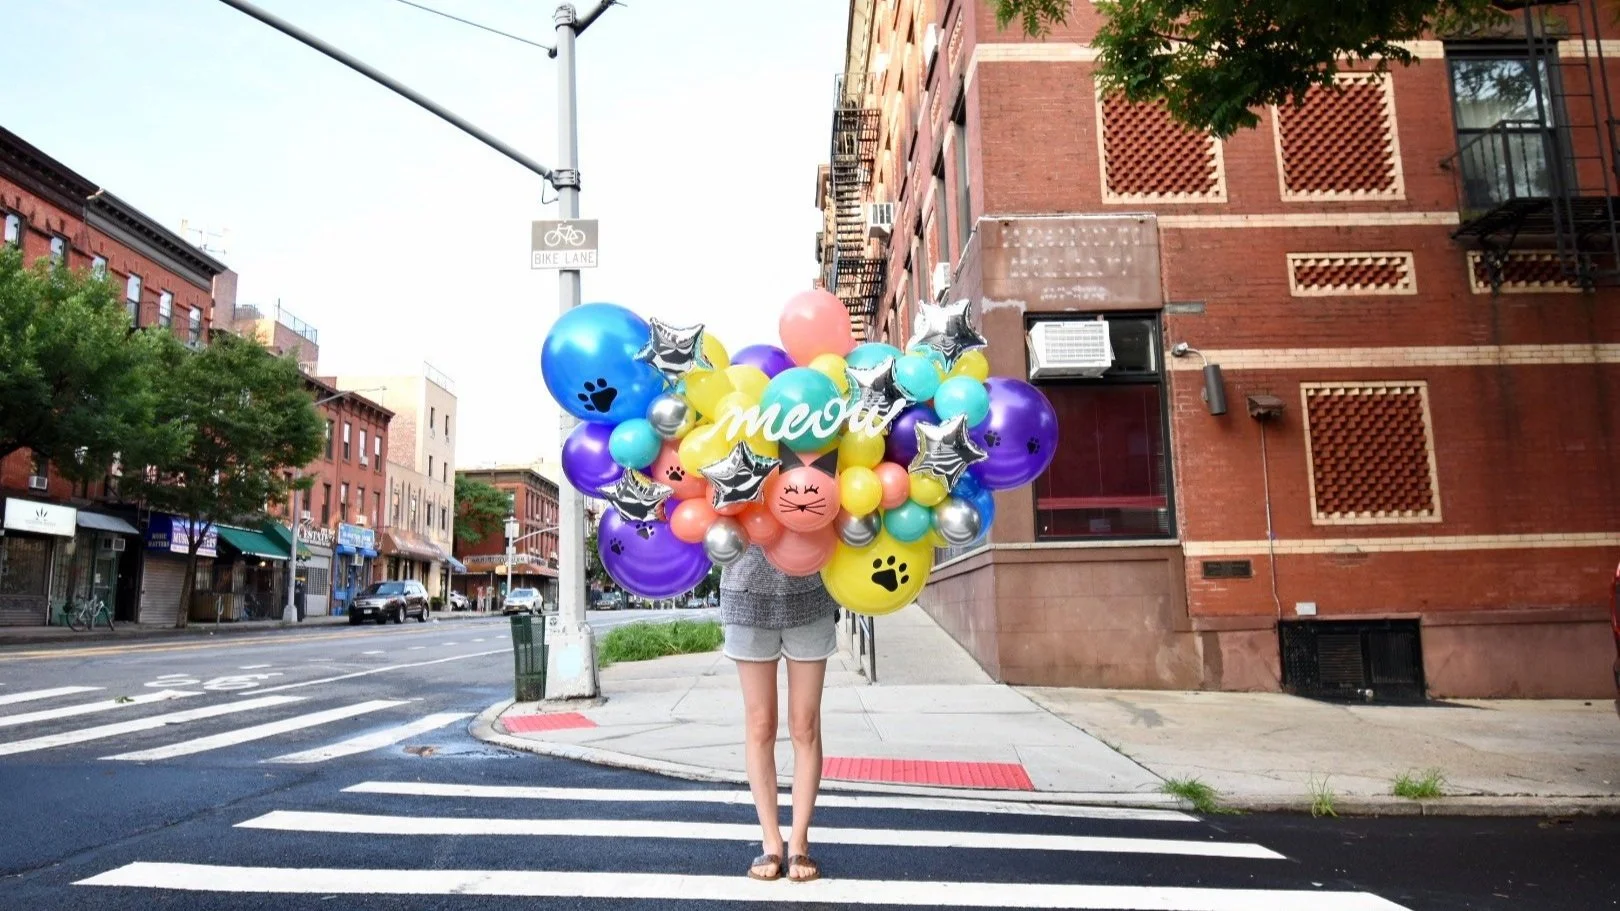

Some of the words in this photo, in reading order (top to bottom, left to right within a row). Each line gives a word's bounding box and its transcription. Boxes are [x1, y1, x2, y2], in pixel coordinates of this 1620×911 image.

[534, 252, 559, 265] BIKE
[565, 251, 594, 264] LANE
[696, 397, 907, 442] meow
